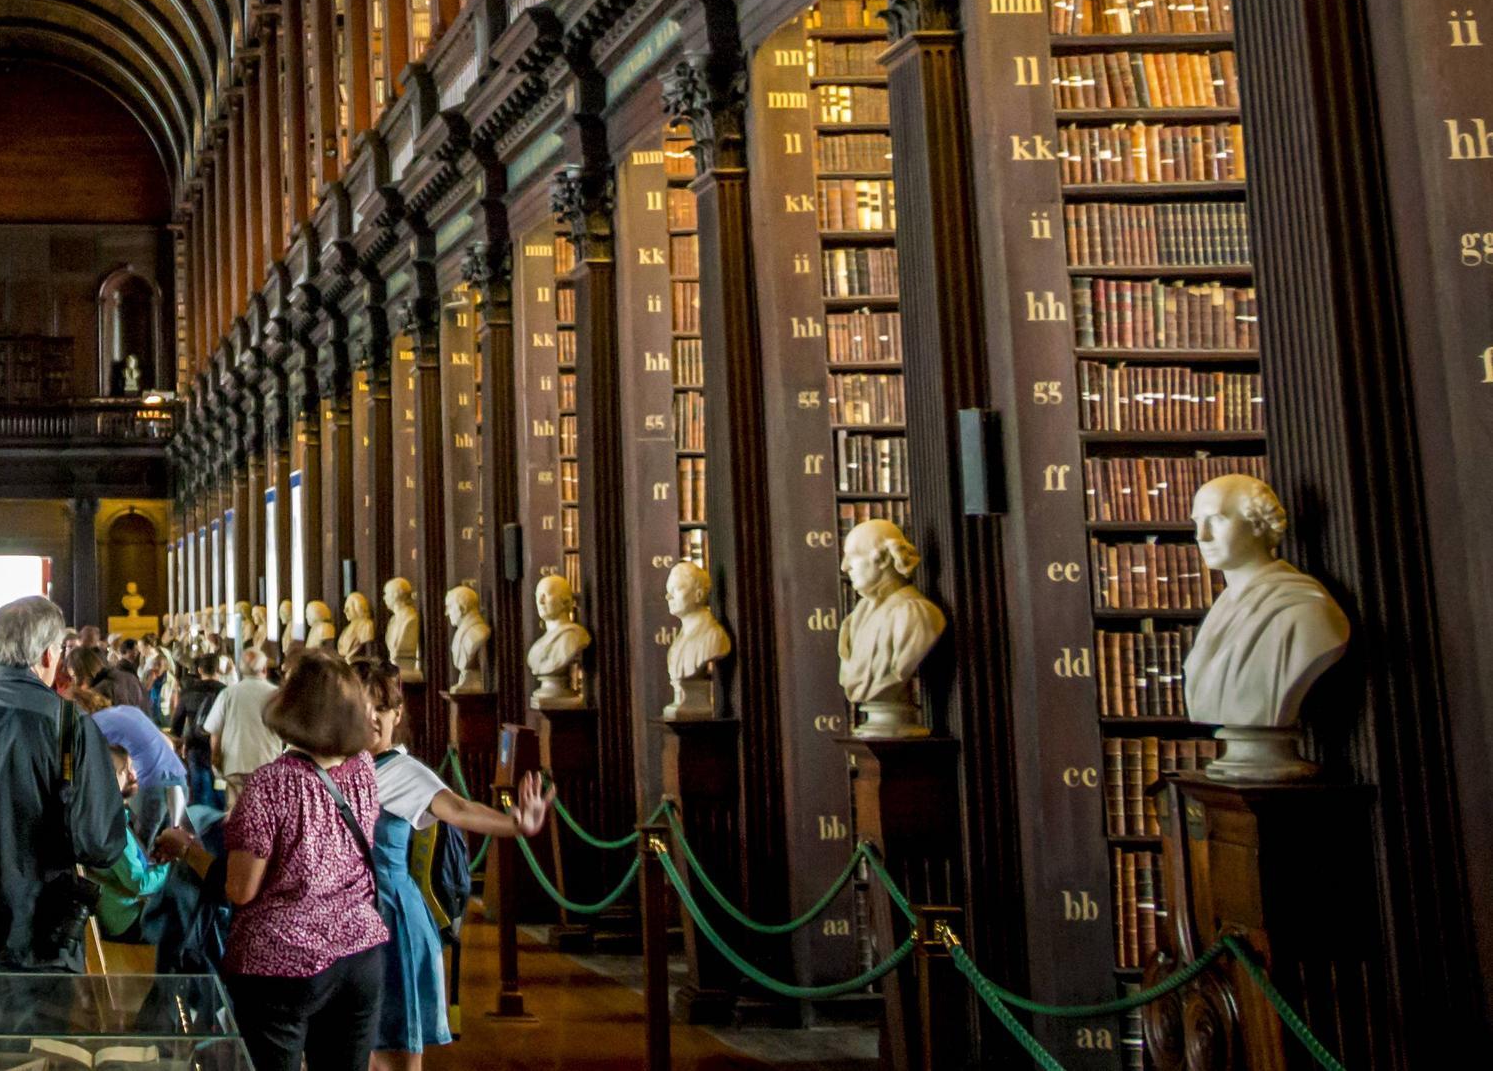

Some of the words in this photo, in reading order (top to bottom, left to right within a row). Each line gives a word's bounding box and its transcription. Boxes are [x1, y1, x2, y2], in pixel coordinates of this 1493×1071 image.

[1447, 9, 1483, 47] ii
[774, 49, 805, 66] nn
[1013, 56, 1041, 86] ll
[767, 91, 809, 109] mm
[784, 132, 803, 154] ll
[1010, 135, 1056, 161] kk
[632, 149, 665, 166] mm
[646, 191, 663, 211] ll
[784, 194, 816, 213] kk
[1030, 211, 1053, 239] ii
[638, 247, 666, 265] kk
[794, 253, 811, 274] ii
[647, 294, 662, 313] ii
[1025, 291, 1068, 321] hh
[791, 316, 823, 338] hh
[644, 352, 671, 372] hh
[797, 391, 821, 408] gg
[1033, 380, 1063, 405] gg
[644, 414, 666, 430] gg
[804, 454, 824, 475] ff
[1044, 464, 1071, 491] ff
[653, 482, 670, 501] ff
[805, 531, 833, 548] ee
[651, 555, 674, 568] ee
[1047, 562, 1080, 583] ee
[807, 607, 837, 631] dd
[1053, 647, 1091, 678] dd
[814, 715, 841, 731] cc
[1062, 767, 1098, 788] cc
[818, 815, 847, 841] bb
[1061, 890, 1099, 921] bb
[822, 919, 850, 936] aa
[1076, 1028, 1113, 1050] aa
